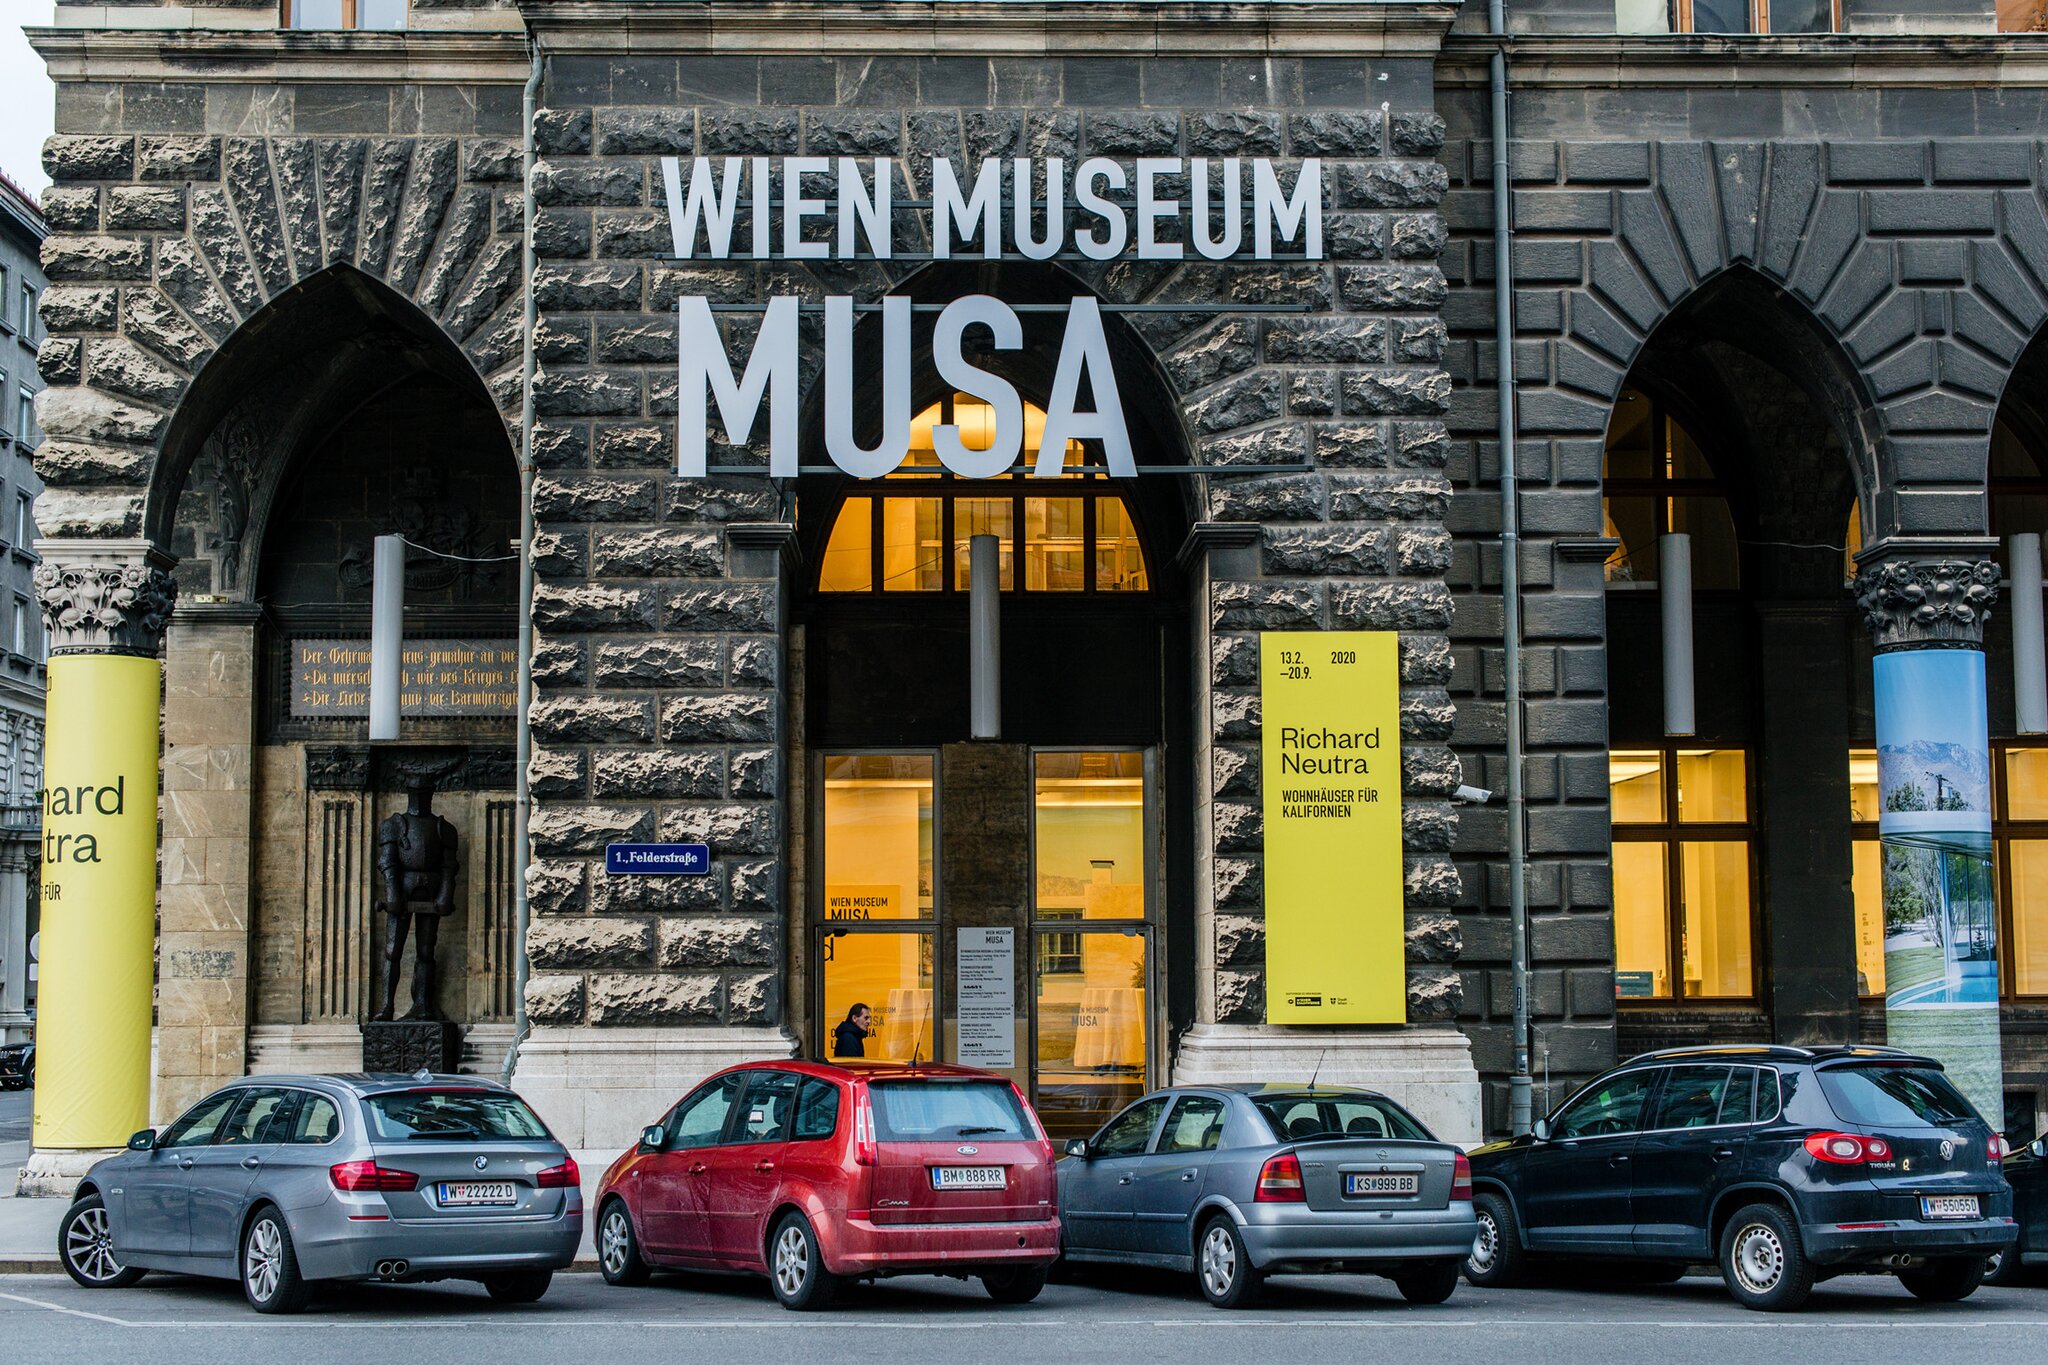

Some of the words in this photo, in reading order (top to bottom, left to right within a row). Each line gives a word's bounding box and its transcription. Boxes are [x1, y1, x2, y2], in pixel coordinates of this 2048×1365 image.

[660, 156, 892, 259] WIEN
[932, 156, 1324, 260] MUSEUM
[677, 294, 1139, 479] MUSA
[303, 648, 323, 664] Der
[402, 648, 424, 665] iens
[430, 646, 475, 668] gemahne
[480, 649, 494, 664] an
[500, 649, 516, 664] die
[1281, 651, 1304, 664] 13.2.
[1331, 651, 1356, 664] 2020
[312, 669, 328, 686] Da
[417, 669, 435, 685] wie
[440, 670, 458, 685] des
[463, 669, 503, 688] Krieges
[312, 690, 330, 706] Die
[429, 692, 445, 706] die
[1281, 727, 1380, 749] Richard
[1282, 752, 1369, 774] Neutra
[1282, 787, 1355, 803] WOHNHÄUSER
[1358, 787, 1378, 803] FÜR
[1282, 805, 1351, 818] KALIFORNIEN
[44, 881, 61, 901] FÜR
[830, 896, 851, 907] WIEN
[853, 896, 888, 907] MUSEUM
[985, 936, 1004, 944] MUSA
[1071, 1015, 1098, 1027] MUSA
[943, 1169, 958, 1183] BM
[966, 1169, 986, 1182] 888
[987, 1169, 1002, 1182] RR
[448, 1185, 457, 1198] W
[466, 1184, 503, 1198] 22222
[506, 1185, 512, 1197] D
[1357, 1177, 1371, 1191] KS
[1377, 1177, 1397, 1191] 999
[1400, 1177, 1413, 1190] BB
[1929, 1199, 1936, 1212] W
